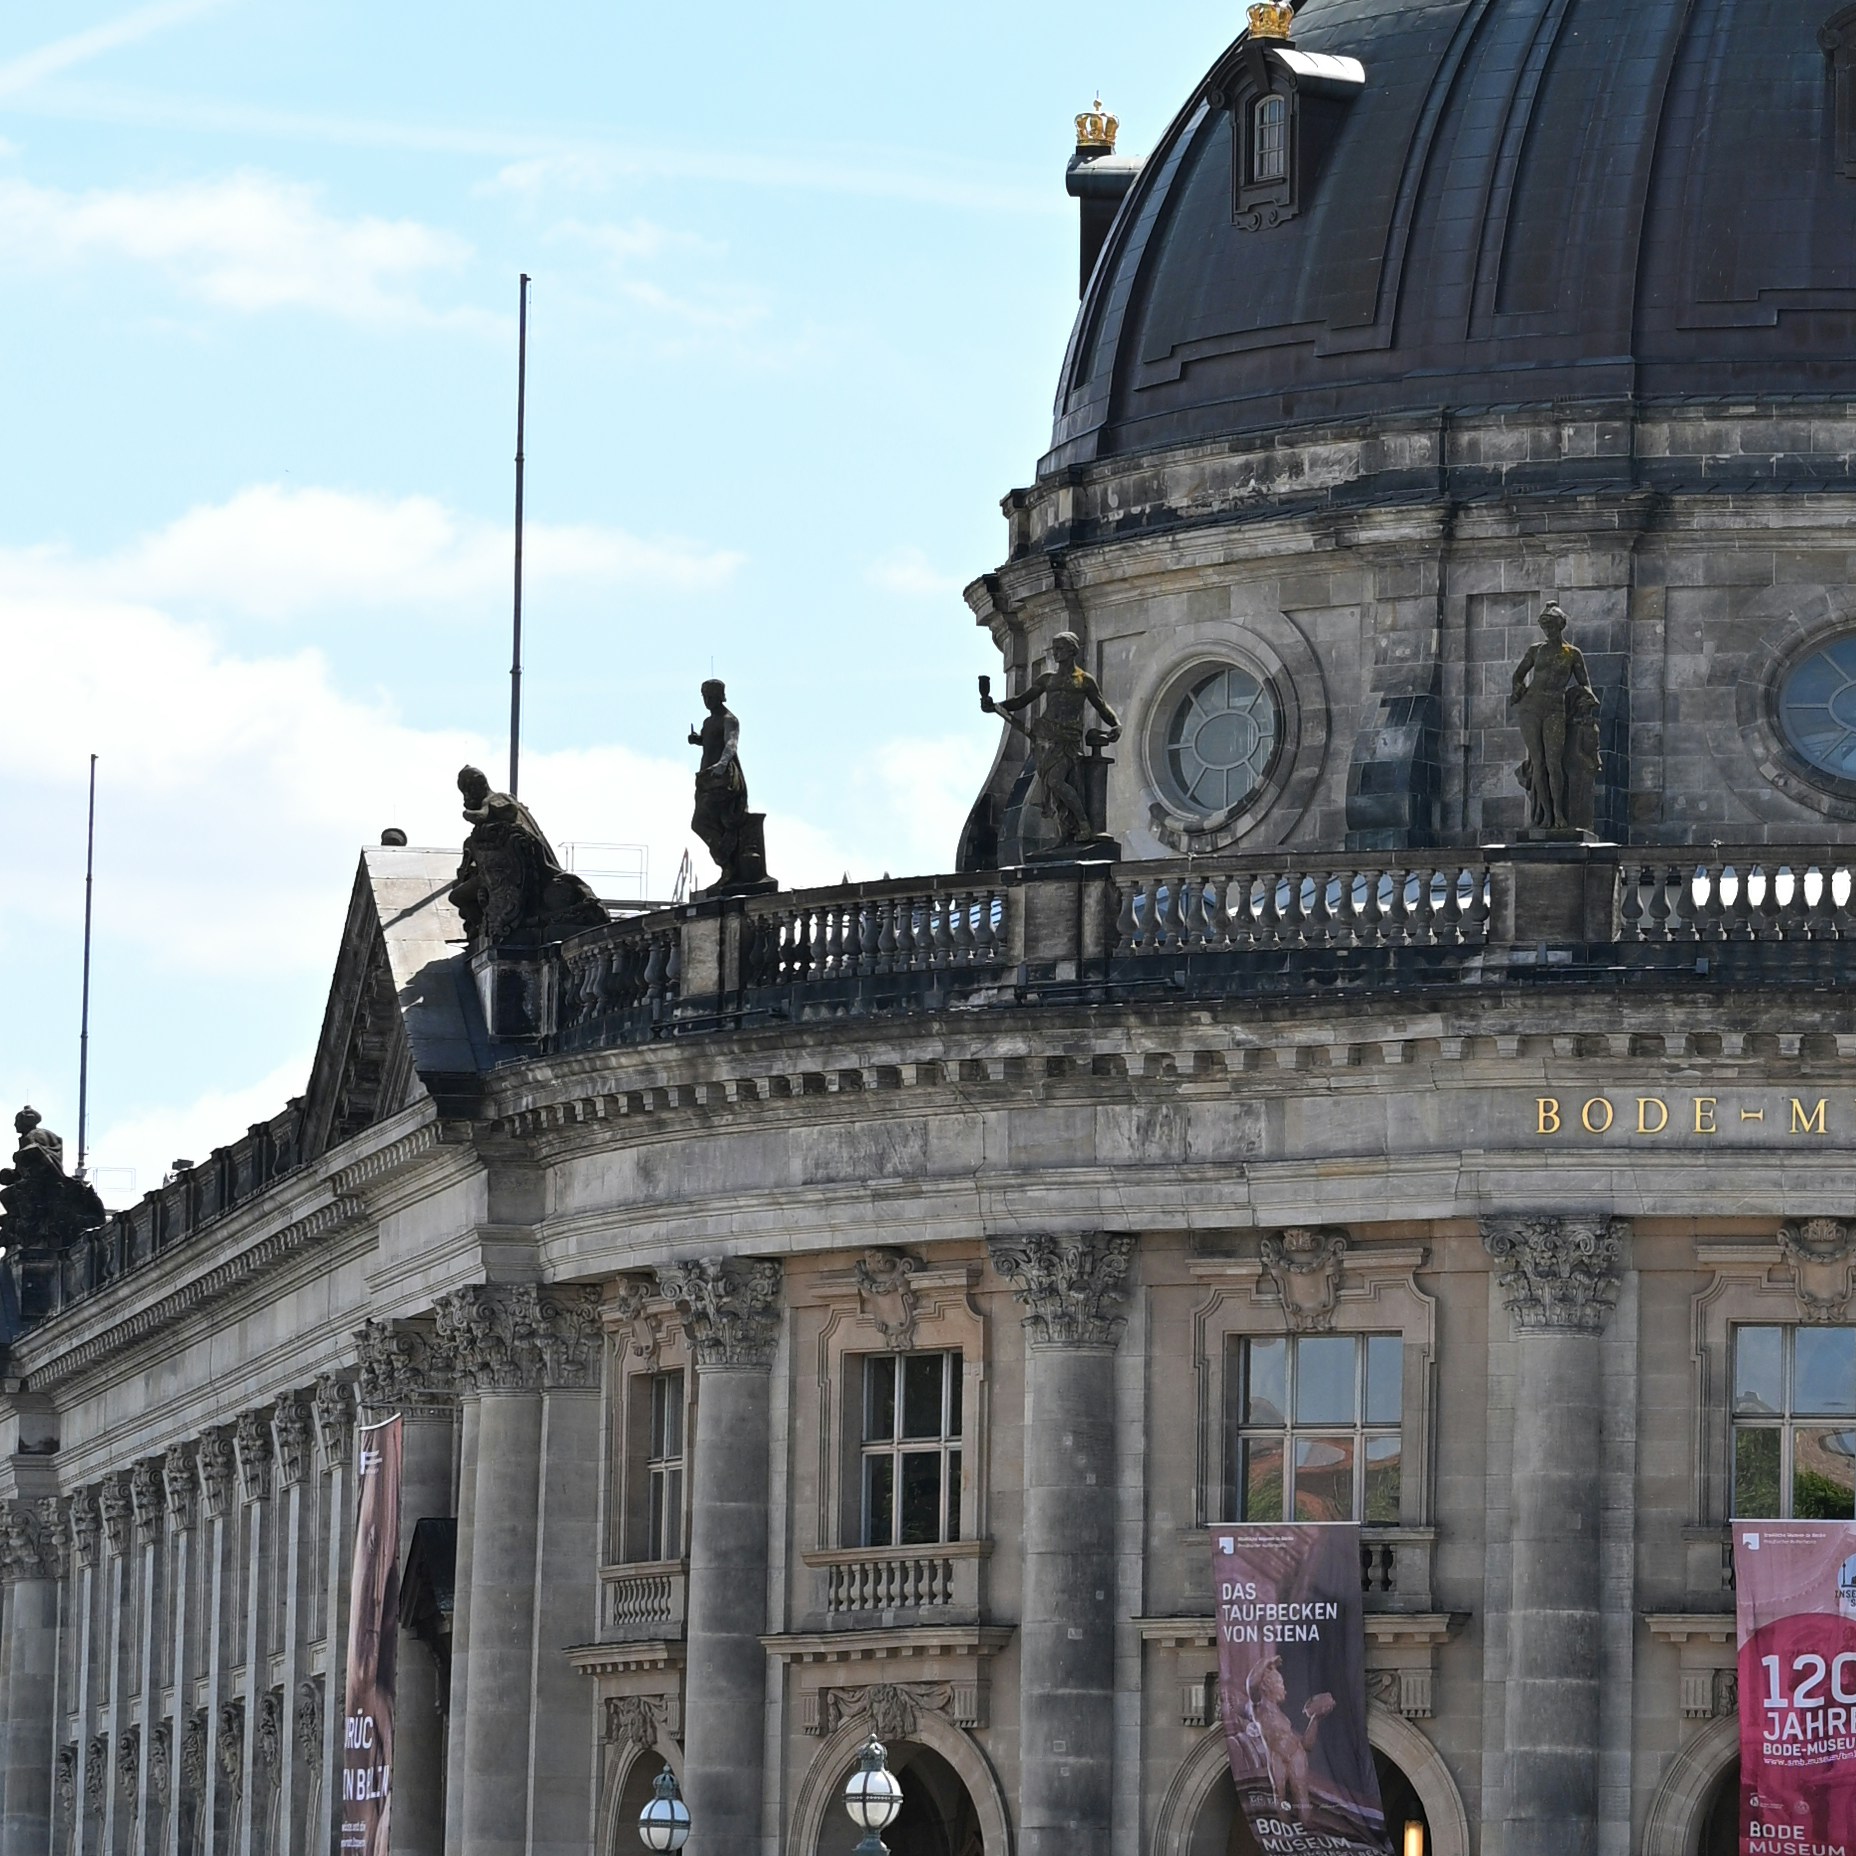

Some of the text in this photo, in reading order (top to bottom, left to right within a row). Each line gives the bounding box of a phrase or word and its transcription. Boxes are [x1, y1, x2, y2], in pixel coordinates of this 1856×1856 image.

[1222, 1582, 1256, 1600] DAS
[1222, 1602, 1338, 1621] TAUFBECKEN
[1223, 1624, 1320, 1643] VON SIENA
[1255, 1818, 1307, 1838] BODE
[1750, 1821, 1805, 1840] BODE
[1262, 1837, 1351, 1853] MUSEUM
[1749, 1841, 1846, 1856] MUSEUM
